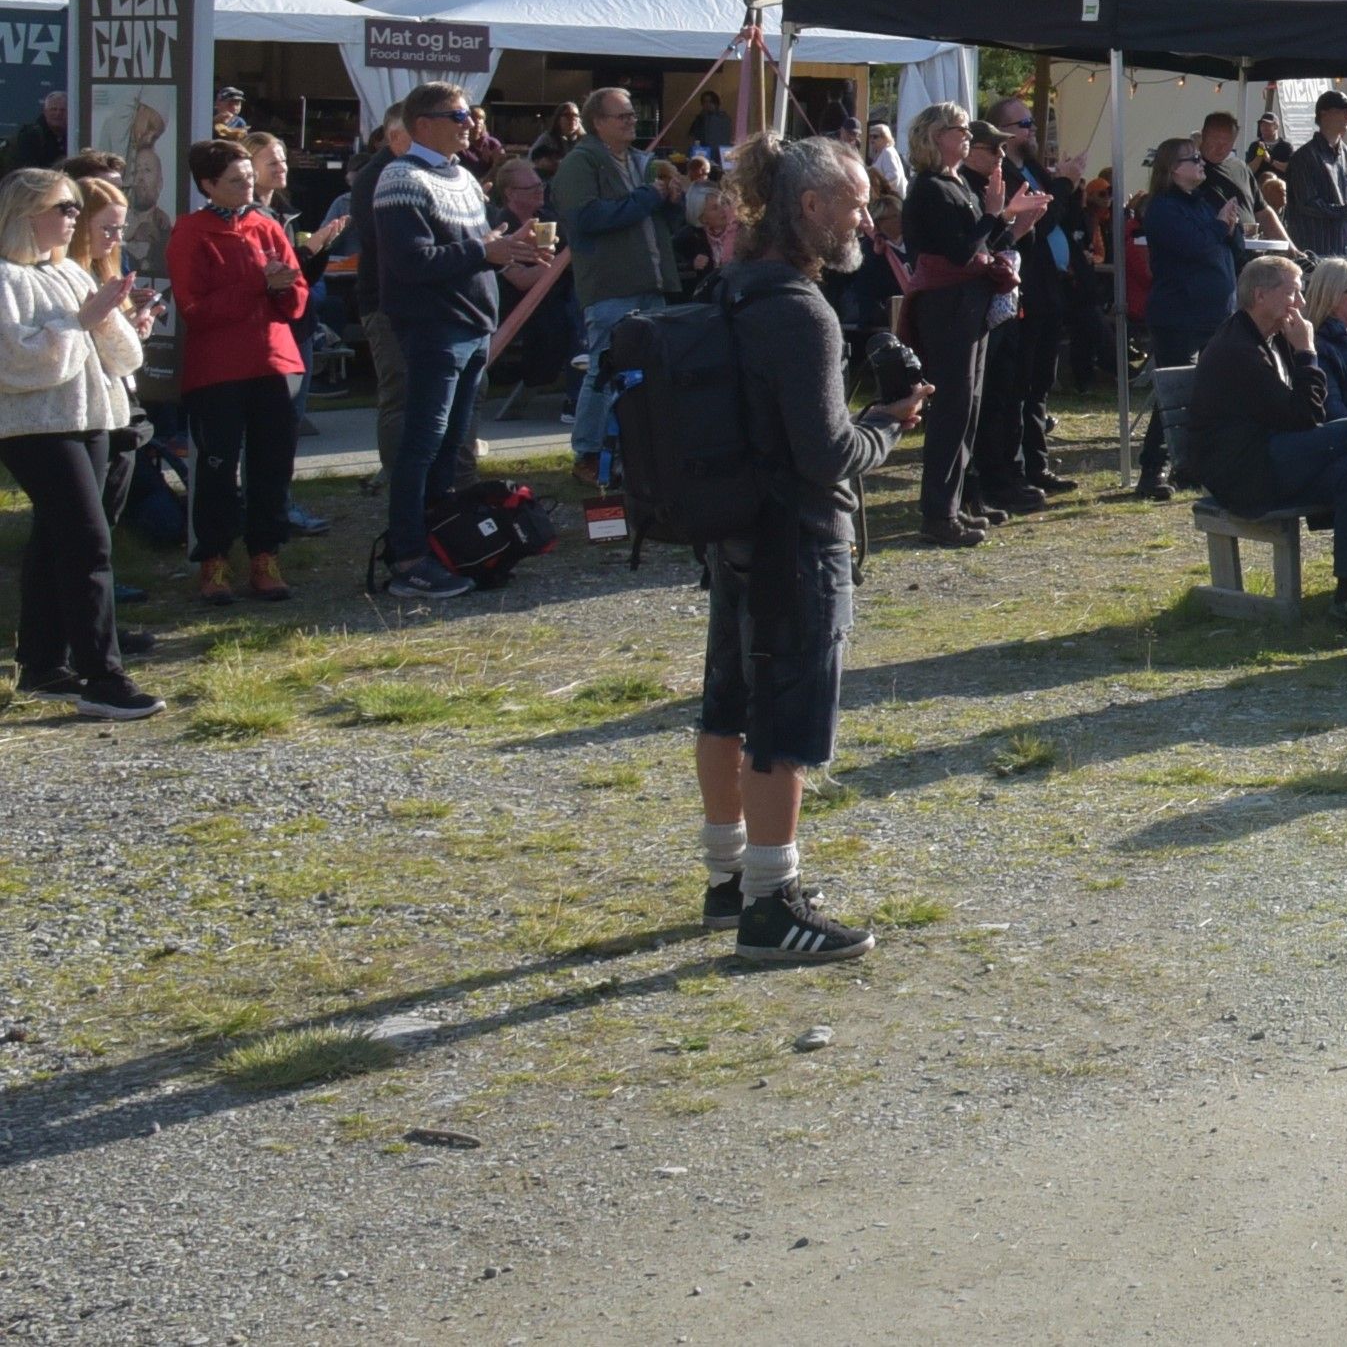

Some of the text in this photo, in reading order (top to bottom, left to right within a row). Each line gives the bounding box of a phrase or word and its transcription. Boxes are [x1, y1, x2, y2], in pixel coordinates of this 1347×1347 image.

[92, 20, 178, 78] GYNT
[370, 27, 483, 51] Mat og bar
[370, 48, 461, 63] Food and drinks
